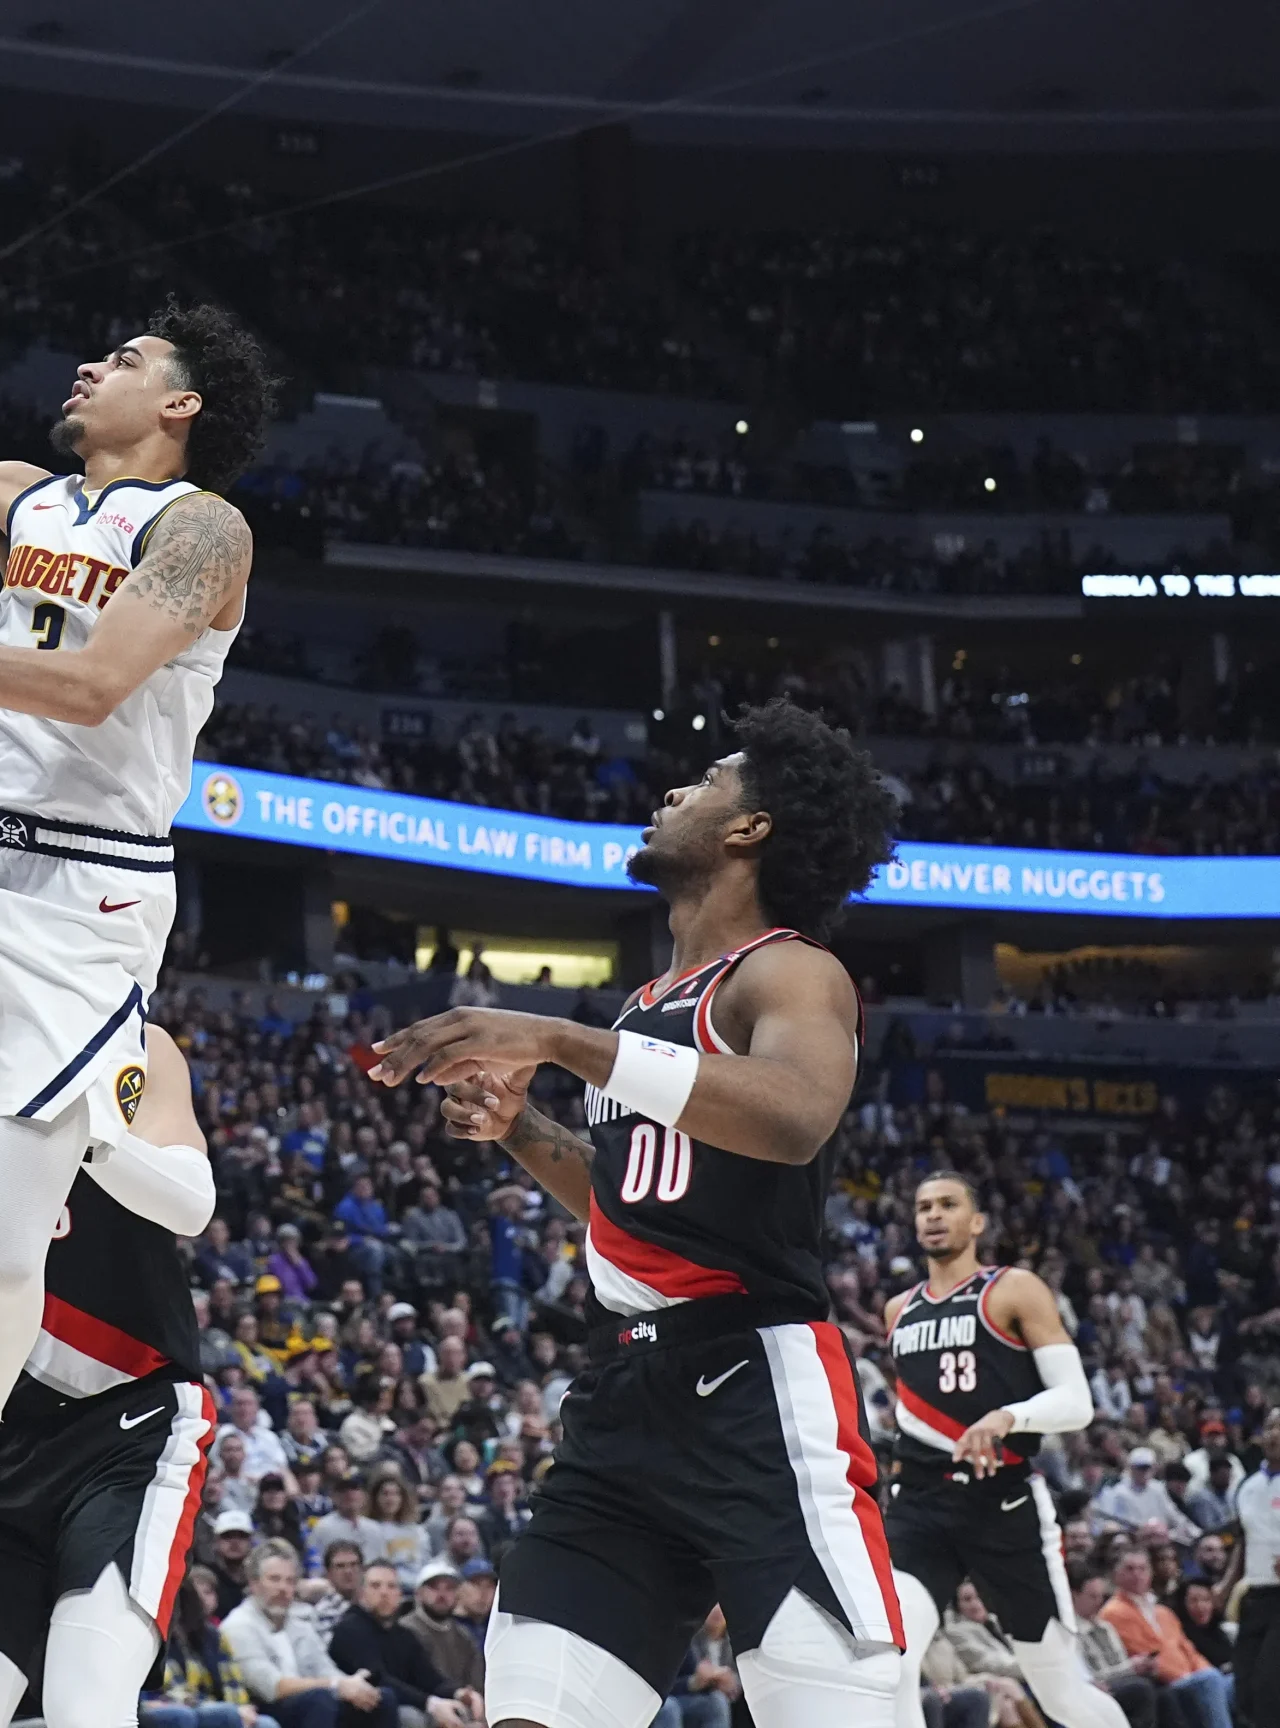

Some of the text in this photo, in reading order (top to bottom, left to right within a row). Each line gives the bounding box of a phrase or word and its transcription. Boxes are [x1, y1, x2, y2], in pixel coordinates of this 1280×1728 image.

[256, 790, 314, 831] THE
[322, 801, 451, 852] OFFICIAL
[457, 823, 518, 860] LAW
[524, 832, 592, 871] FIRM
[887, 859, 1166, 903] DENVER NUGGETS
[620, 1122, 693, 1204] 00
[892, 1314, 977, 1358] PORTLAND
[938, 1350, 978, 1394] 33
